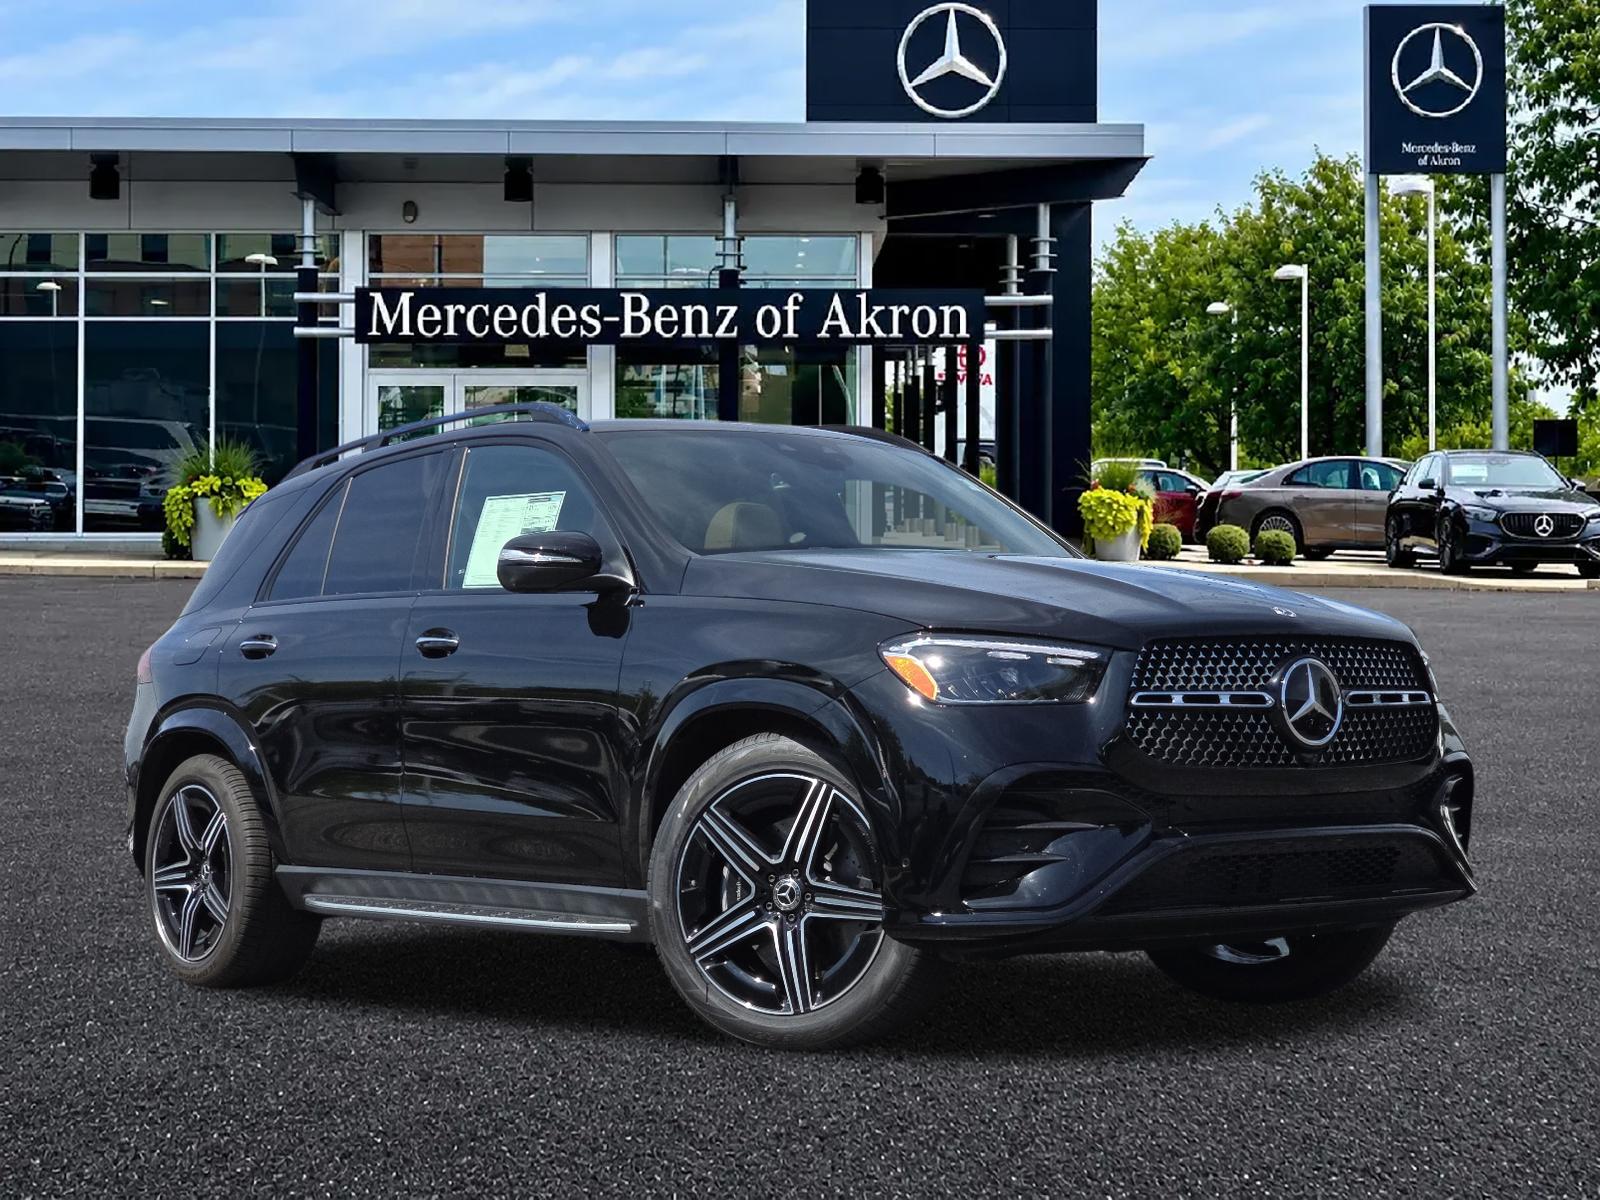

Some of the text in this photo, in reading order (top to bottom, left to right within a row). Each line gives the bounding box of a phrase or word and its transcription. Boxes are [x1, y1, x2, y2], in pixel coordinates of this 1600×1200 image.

[1402, 142, 1476, 153] Mercedes-Benz
[1418, 155, 1460, 165] of Akron
[368, 292, 970, 338] Mercedes-Benz of Akron
